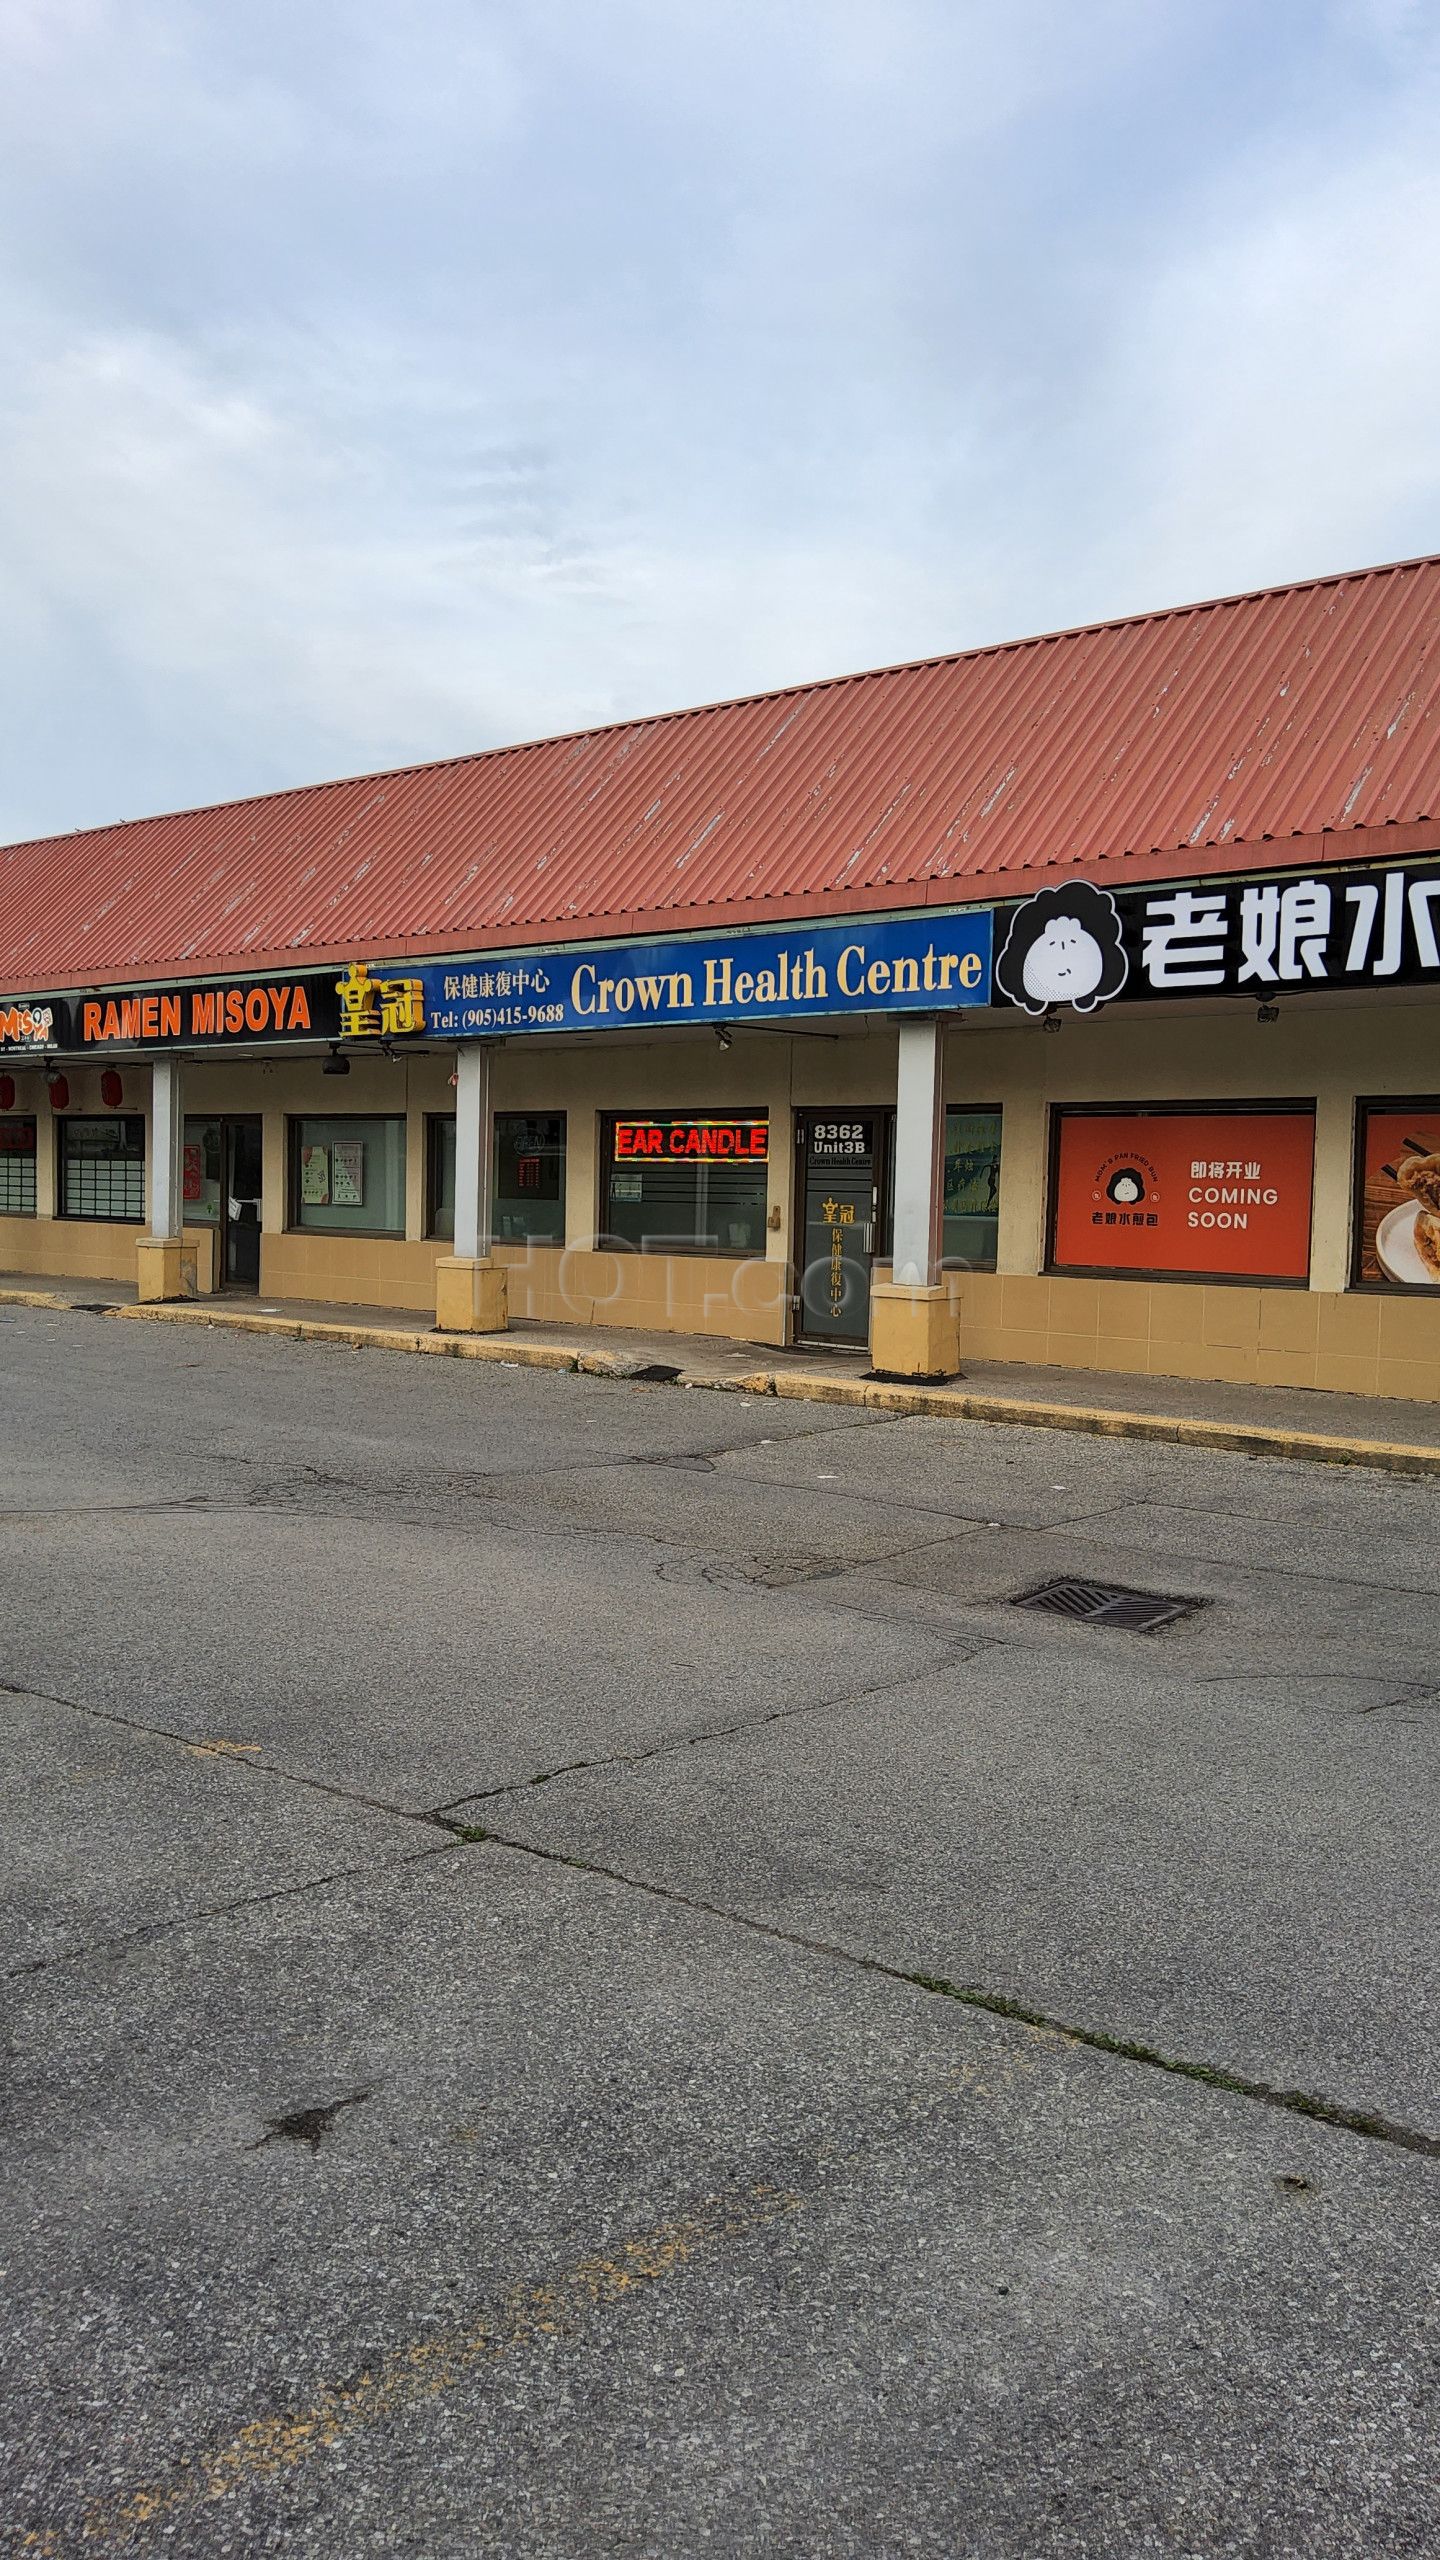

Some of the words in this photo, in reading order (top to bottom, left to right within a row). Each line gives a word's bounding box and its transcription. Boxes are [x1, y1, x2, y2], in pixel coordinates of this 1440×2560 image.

[444, 968, 550, 1001] 保健康復中心
[571, 964, 694, 1015] Crown
[702, 947, 828, 1006] Health
[837, 943, 982, 998] Centre
[83, 996, 181, 1041] RAMEN
[192, 986, 311, 1035] MISOYA
[335, 962, 426, 1038] 皇冠
[431, 1011, 459, 1029] Tel:
[462, 1003, 564, 1030] (905)415-9688
[618, 1129, 663, 1154] EAR
[669, 1128, 768, 1155] CANDLE
[814, 1124, 864, 1140] 8362
[813, 1141, 866, 1154] Unit3B
[1114, 1152, 1129, 1160] PAN
[1130, 1153, 1150, 1167] FRIED
[1147, 1166, 1159, 1183] BUN
[1190, 1161, 1261, 1180] 即将开业
[1188, 1187, 1278, 1205] COMING
[1091, 1211, 1159, 1227] 老娘水煎包
[1188, 1211, 1248, 1230] SOON
